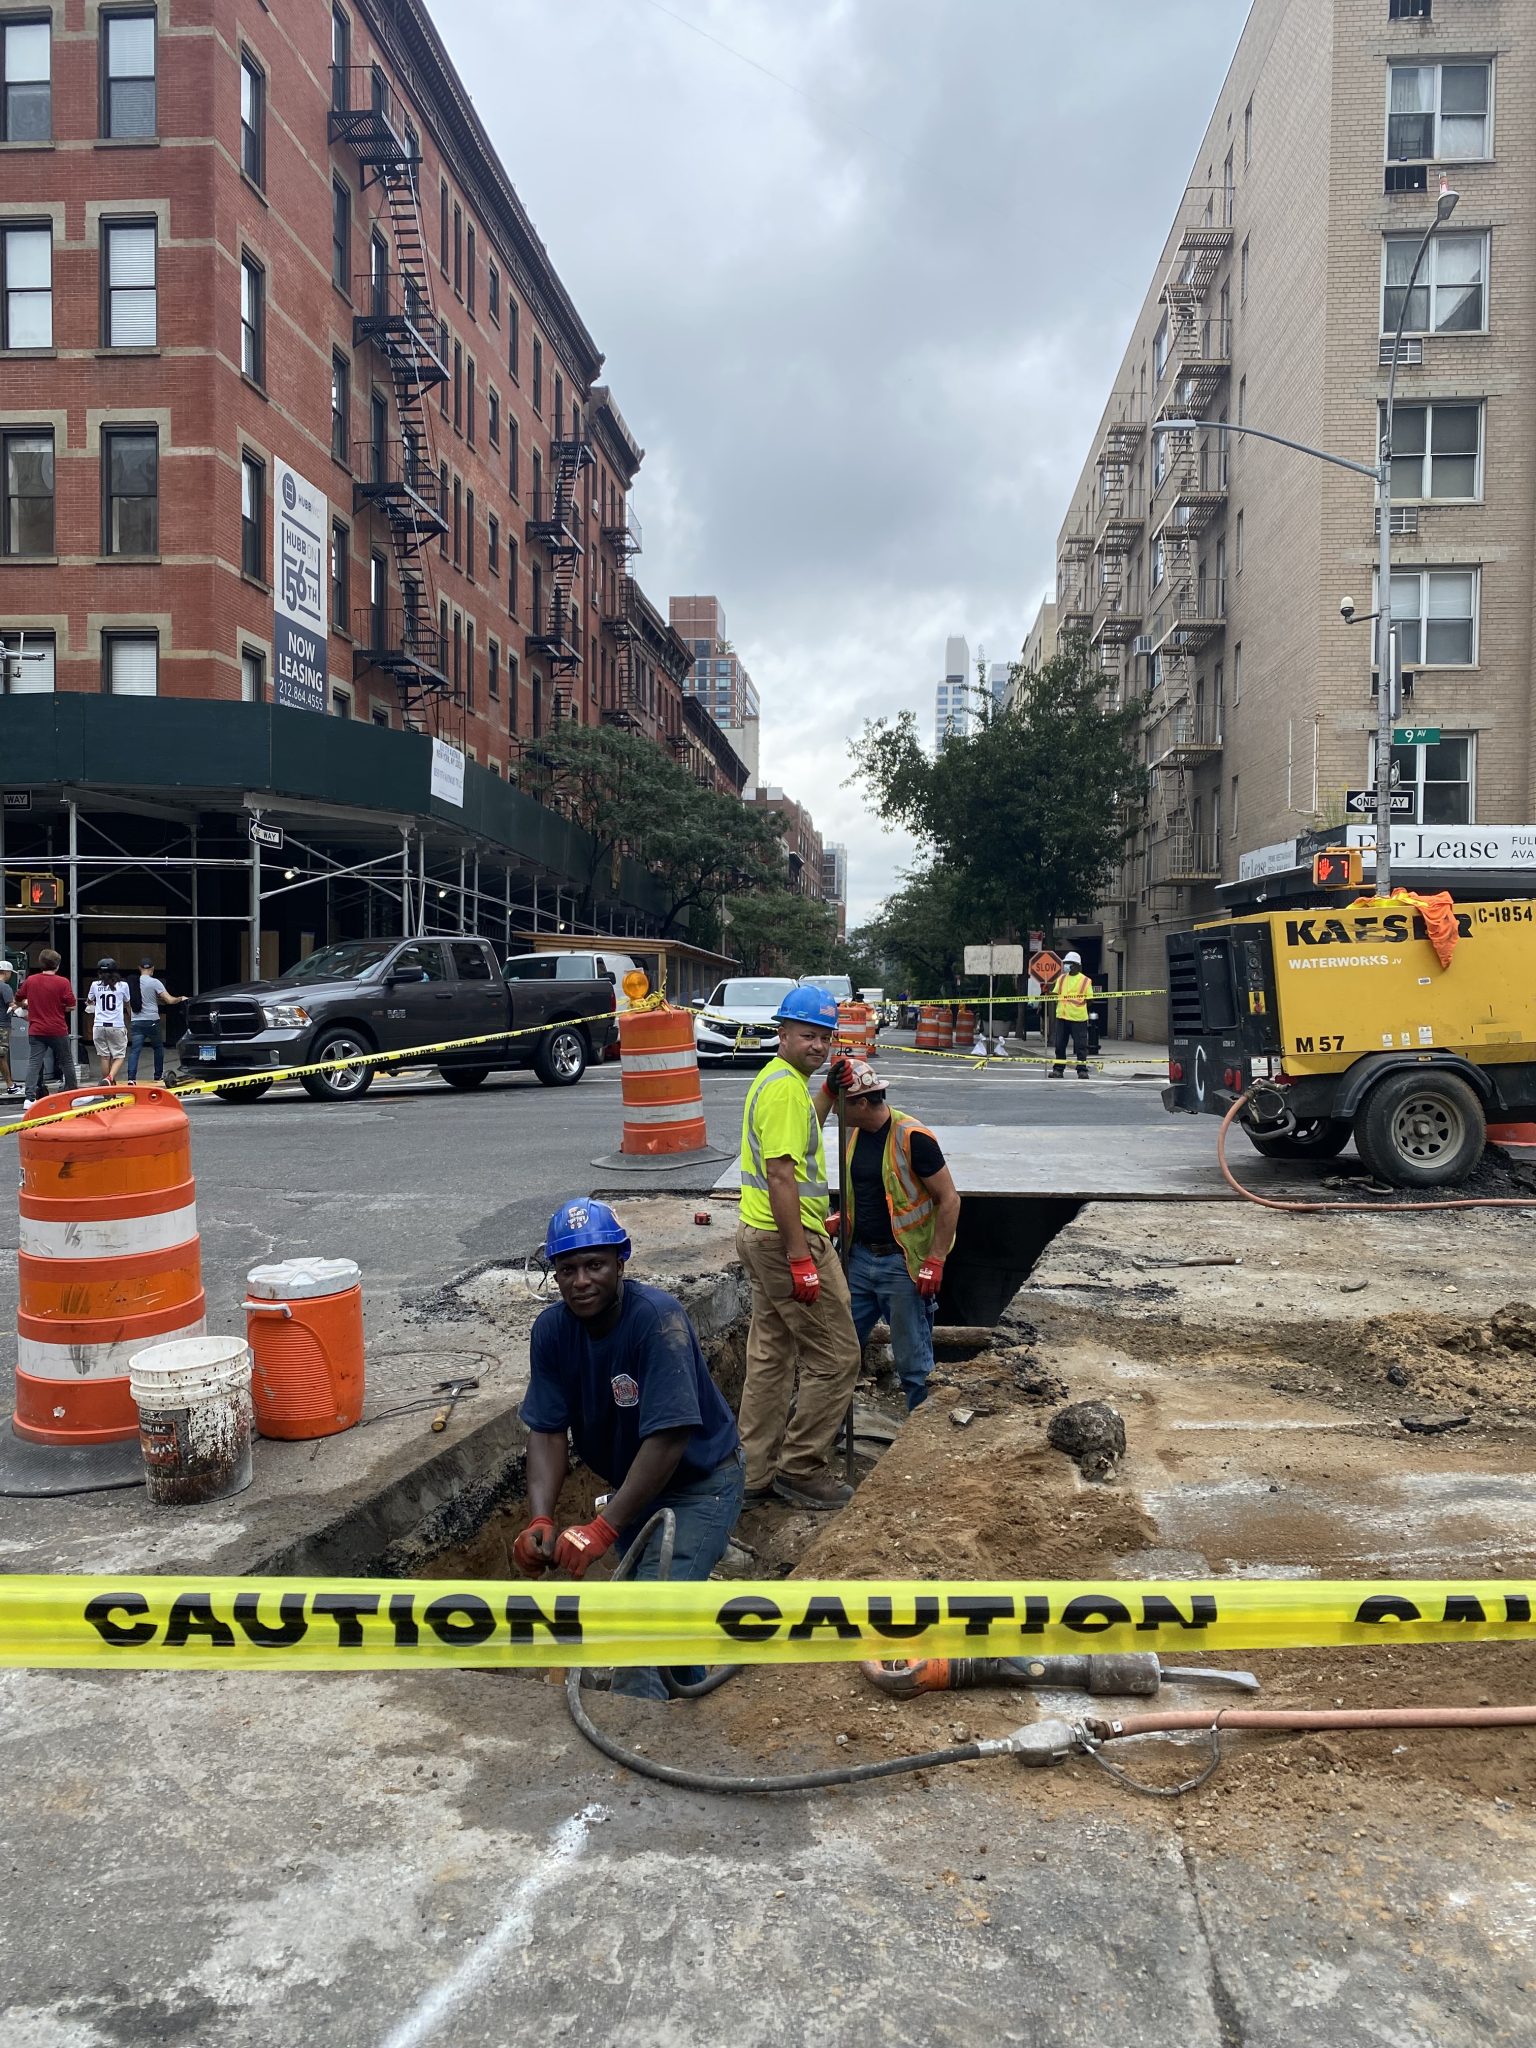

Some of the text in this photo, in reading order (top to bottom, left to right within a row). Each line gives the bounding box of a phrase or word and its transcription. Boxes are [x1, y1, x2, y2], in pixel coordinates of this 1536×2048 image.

[288, 631, 315, 662] NOW
[279, 653, 323, 692] LEASING
[279, 679, 323, 711] 212.864.4555
[1404, 729, 1427, 743] 9 AV
[6, 795, 26, 804] WAY
[1356, 797, 1376, 807] ONE
[1357, 834, 1406, 859] Fr
[1416, 834, 1499, 859] Lease
[1511, 836, 1536, 846] FUL
[1478, 906, 1533, 923] C-1854
[1036, 963, 1057, 972] SLOW
[1288, 954, 1389, 970] WATERWORKS
[100, 993, 117, 1011] 10
[1295, 1035, 1345, 1053] M 57
[84, 1591, 584, 1649] CAUTION
[715, 1593, 1219, 1643] CAUTION
